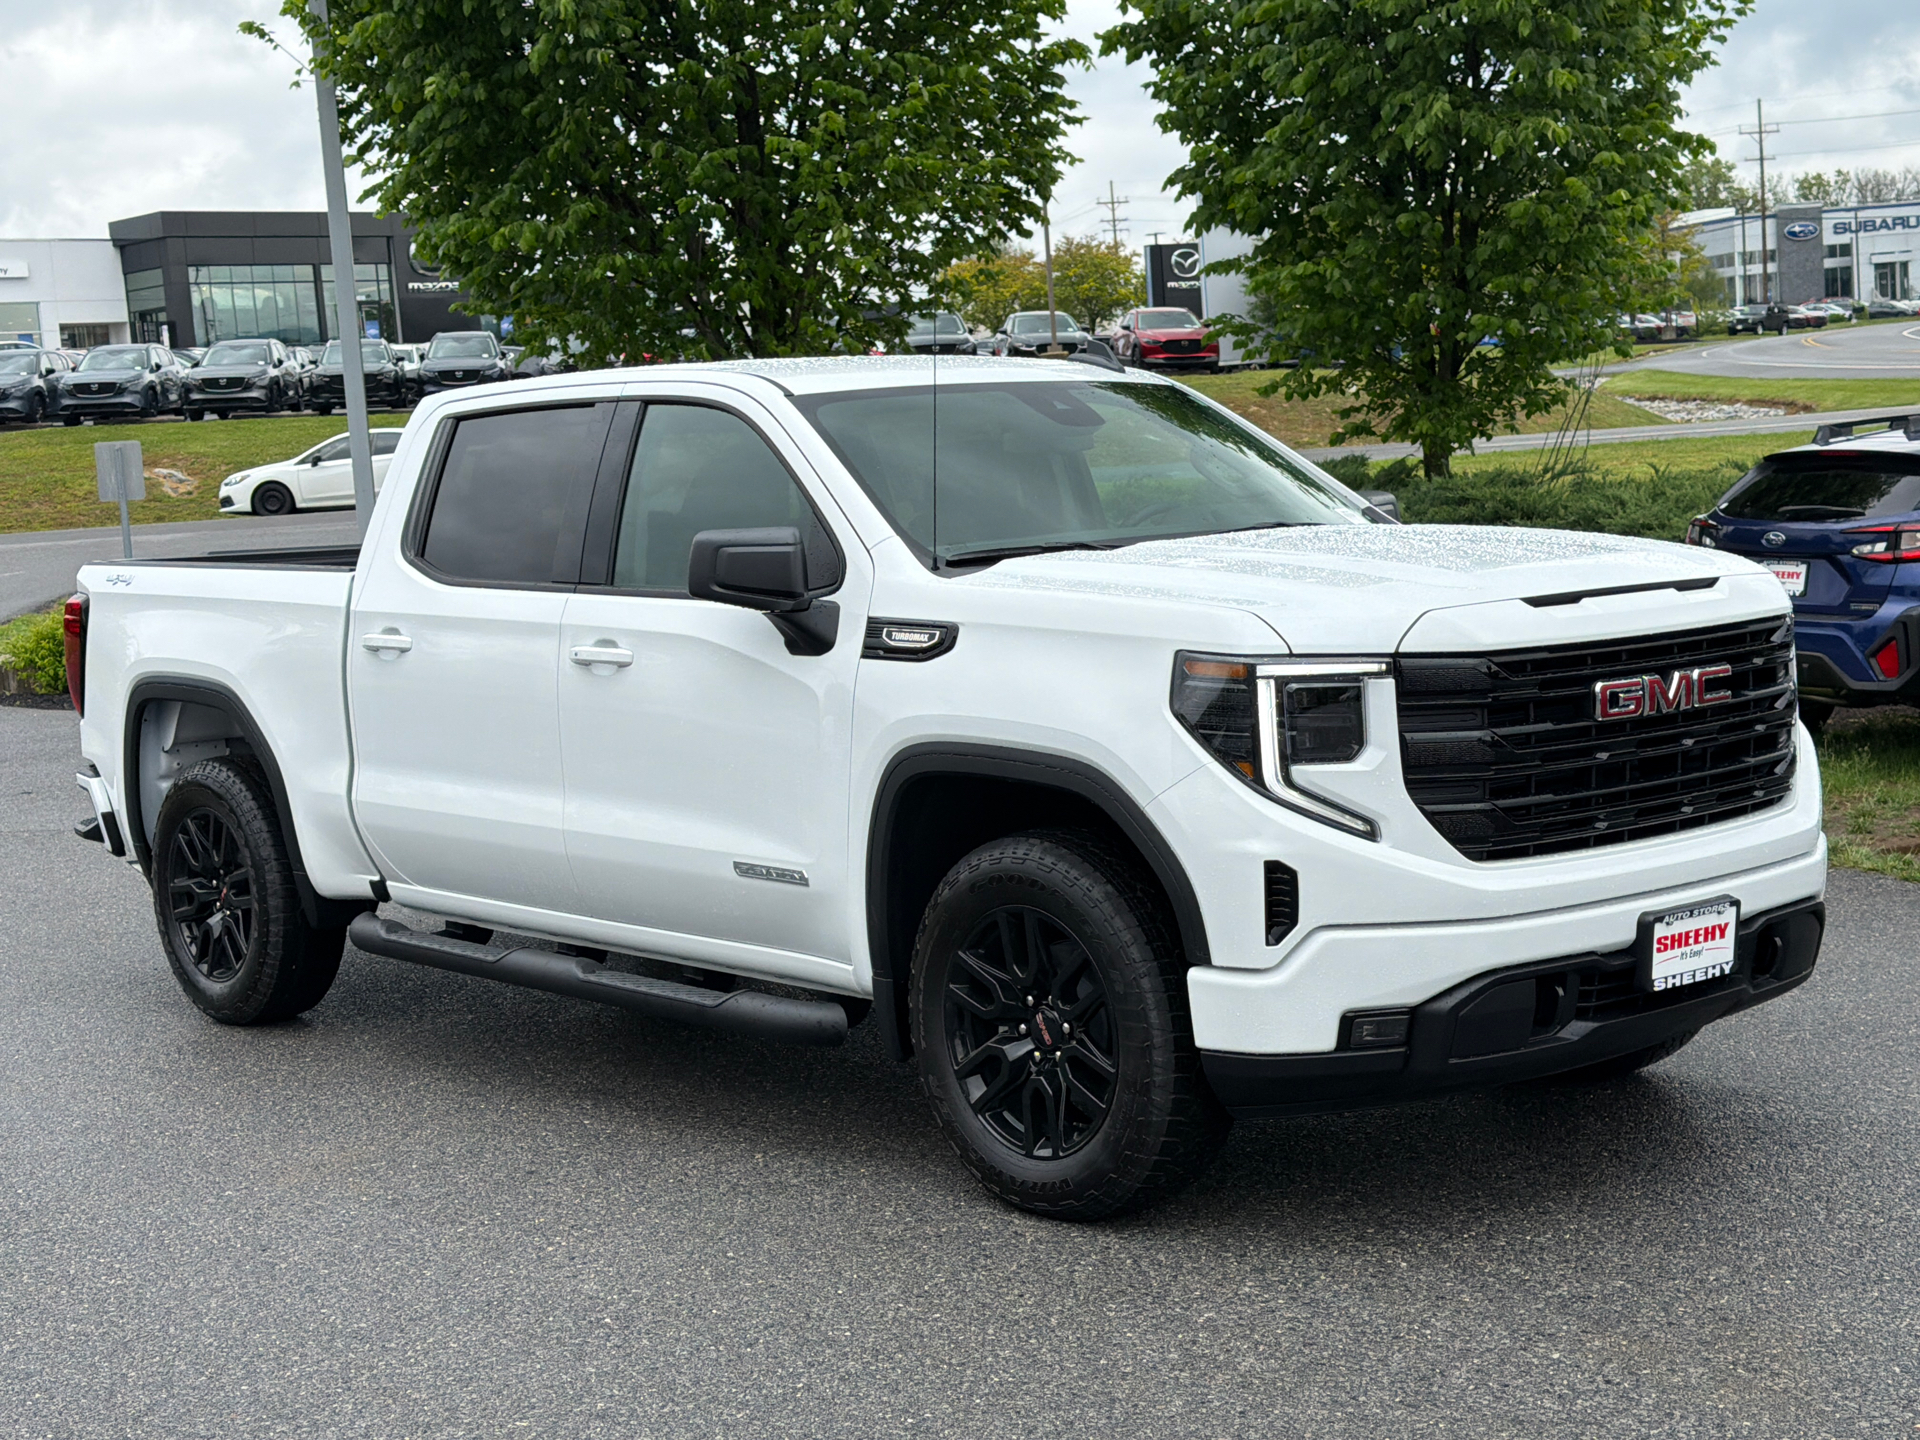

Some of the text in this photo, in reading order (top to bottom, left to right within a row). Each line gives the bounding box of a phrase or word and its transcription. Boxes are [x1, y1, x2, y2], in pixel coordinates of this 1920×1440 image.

[1833, 215, 1920, 235] SUBARU
[891, 631, 930, 642] TURBOMAX
[1594, 664, 1732, 721] GMC
[1663, 903, 1730, 923] AUTO STORES
[1656, 922, 1730, 953] SHEEHY
[1679, 946, 1704, 960] It's Easy!
[1653, 961, 1734, 992] SHEEHY
